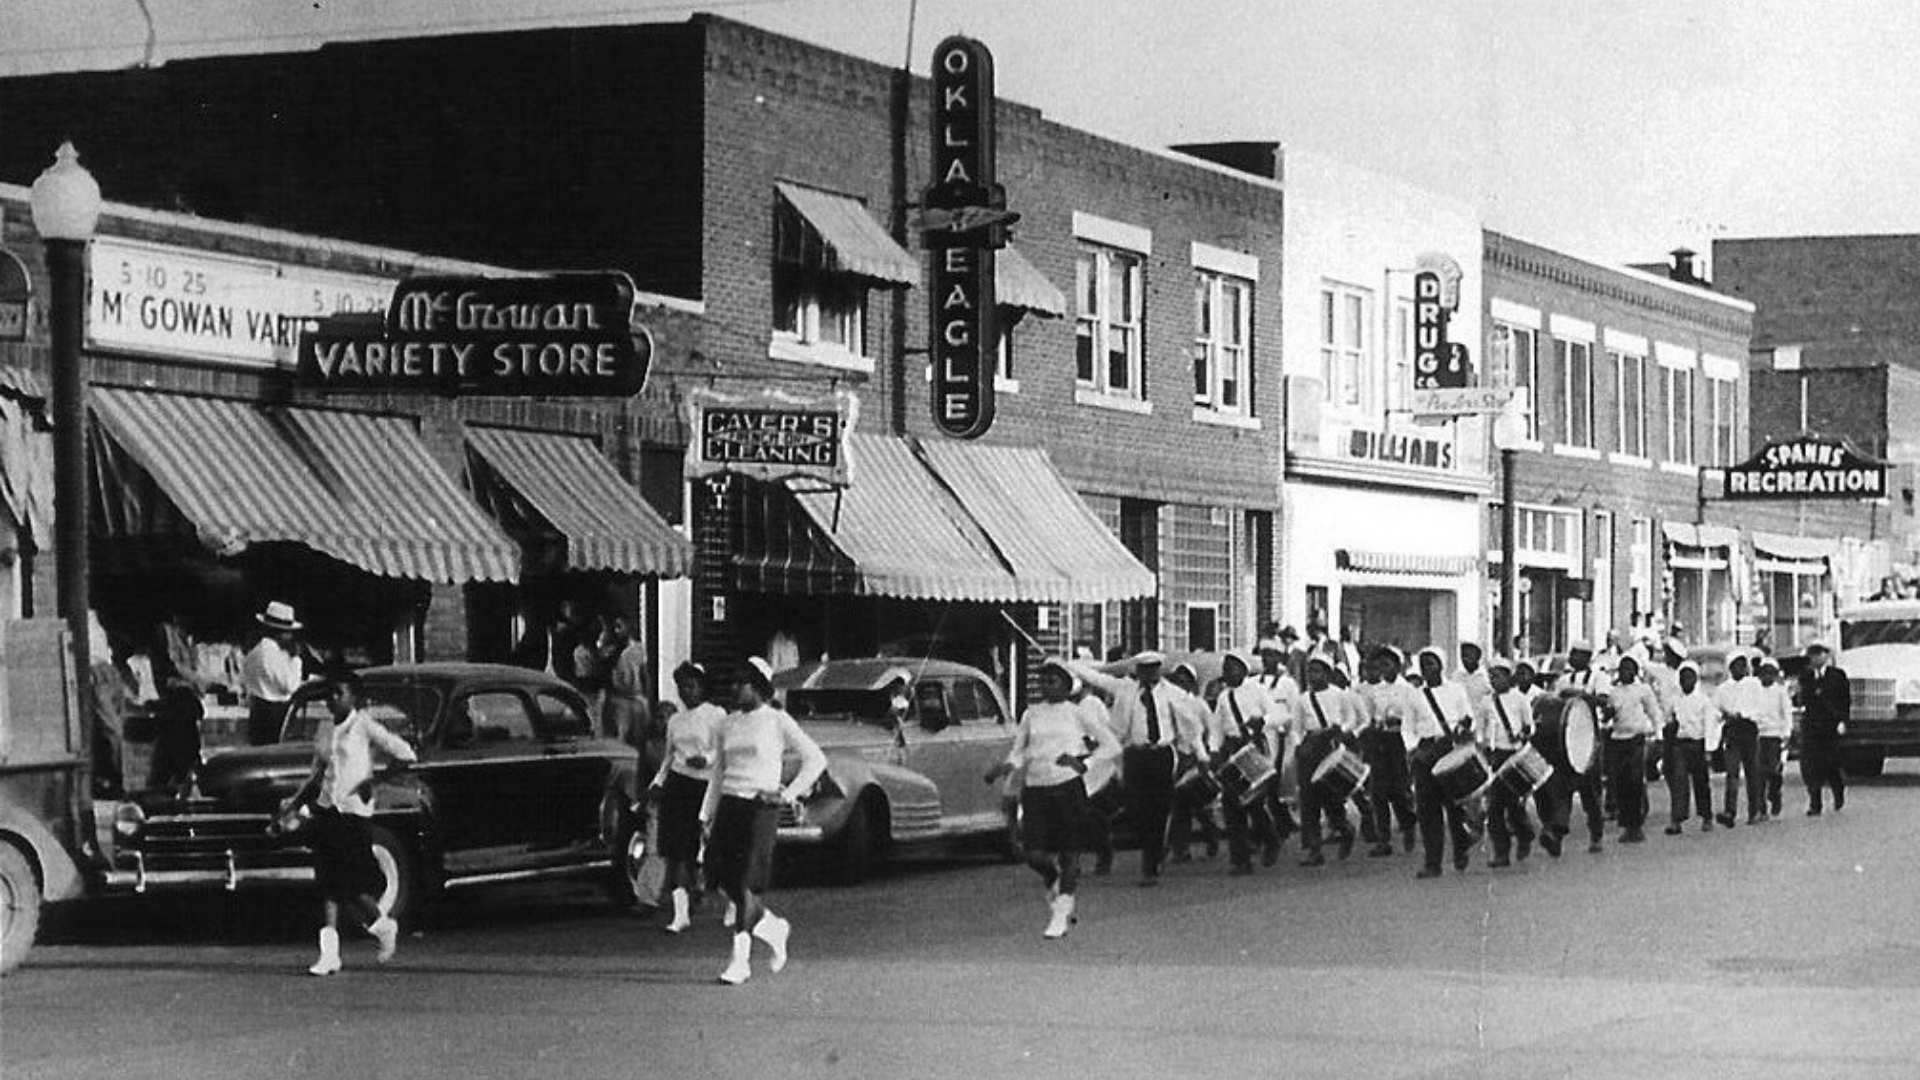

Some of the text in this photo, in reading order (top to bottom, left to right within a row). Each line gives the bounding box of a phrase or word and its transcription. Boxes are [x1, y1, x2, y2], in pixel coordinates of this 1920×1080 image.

[944, 50, 970, 182] OKLA
[183, 271, 207, 296] 25
[140, 297, 233, 339] GOWAN
[246, 309, 297, 347] VARI
[944, 248, 970, 419] EAGLE
[1417, 279, 1440, 373] DRUG
[314, 342, 615, 377] VARIETY STORE
[1350, 429, 1451, 469] WILLIAMS
[1730, 470, 1879, 492] RECREATION
